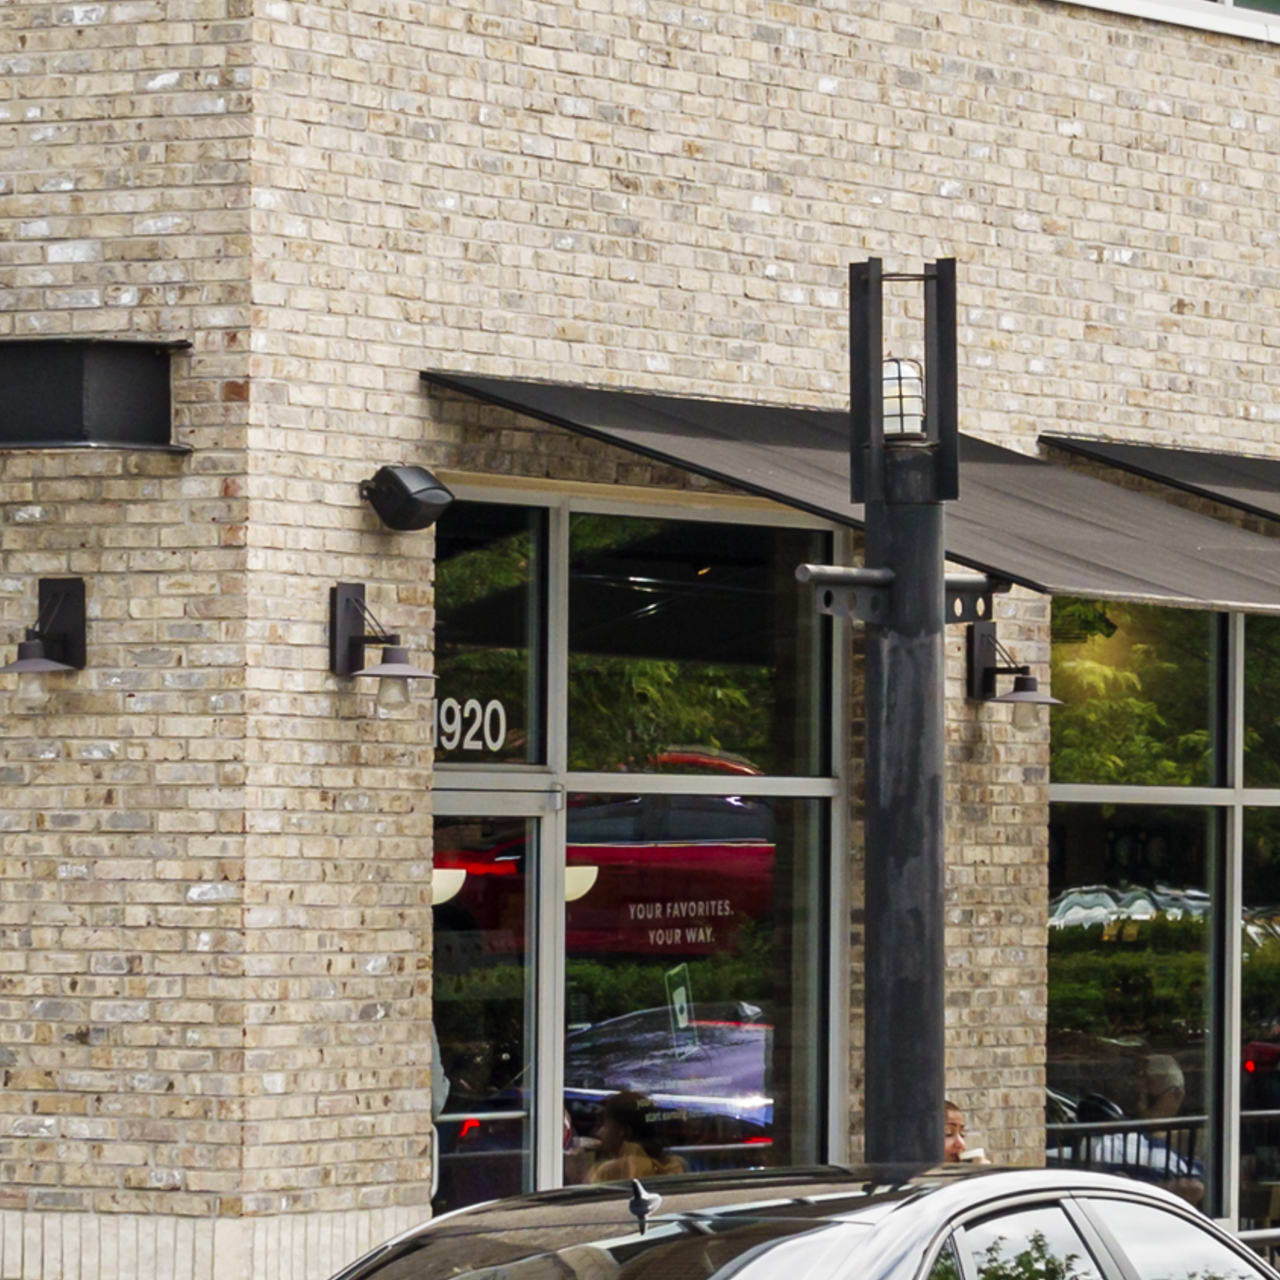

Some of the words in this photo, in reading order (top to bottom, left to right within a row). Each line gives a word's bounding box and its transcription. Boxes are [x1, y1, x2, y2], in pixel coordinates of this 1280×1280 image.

[628, 903, 662, 919] YOUR
[666, 900, 734, 917] FAVORITES.
[648, 929, 681, 945] YOUR
[685, 927, 715, 943] WAY.
